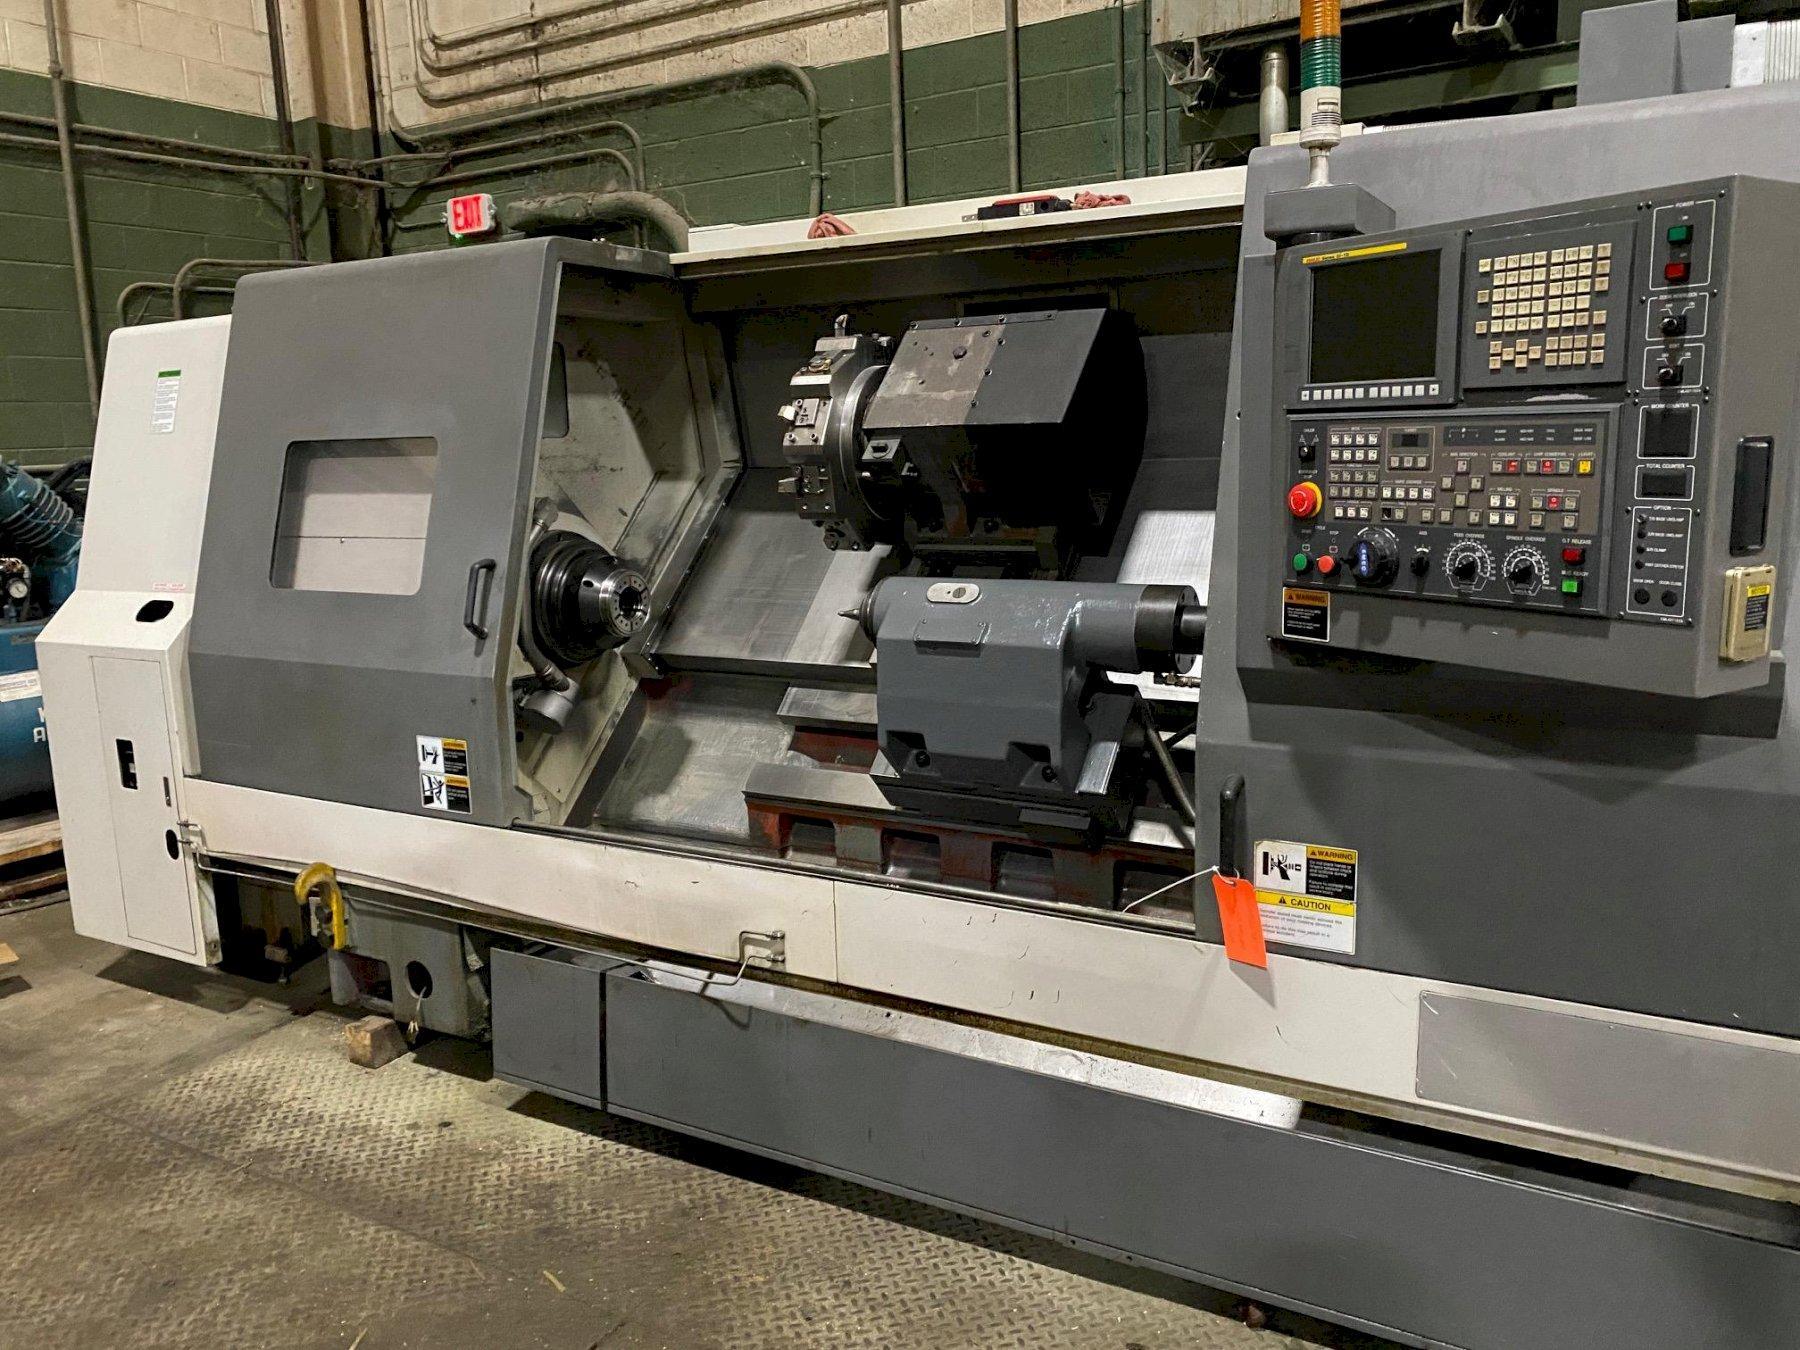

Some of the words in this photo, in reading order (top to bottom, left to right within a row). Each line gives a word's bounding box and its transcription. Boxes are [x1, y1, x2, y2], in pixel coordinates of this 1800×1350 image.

[453, 196, 482, 231] EXIT
[1317, 850, 1353, 861] WARNING
[1291, 898, 1331, 911] CAUTION
